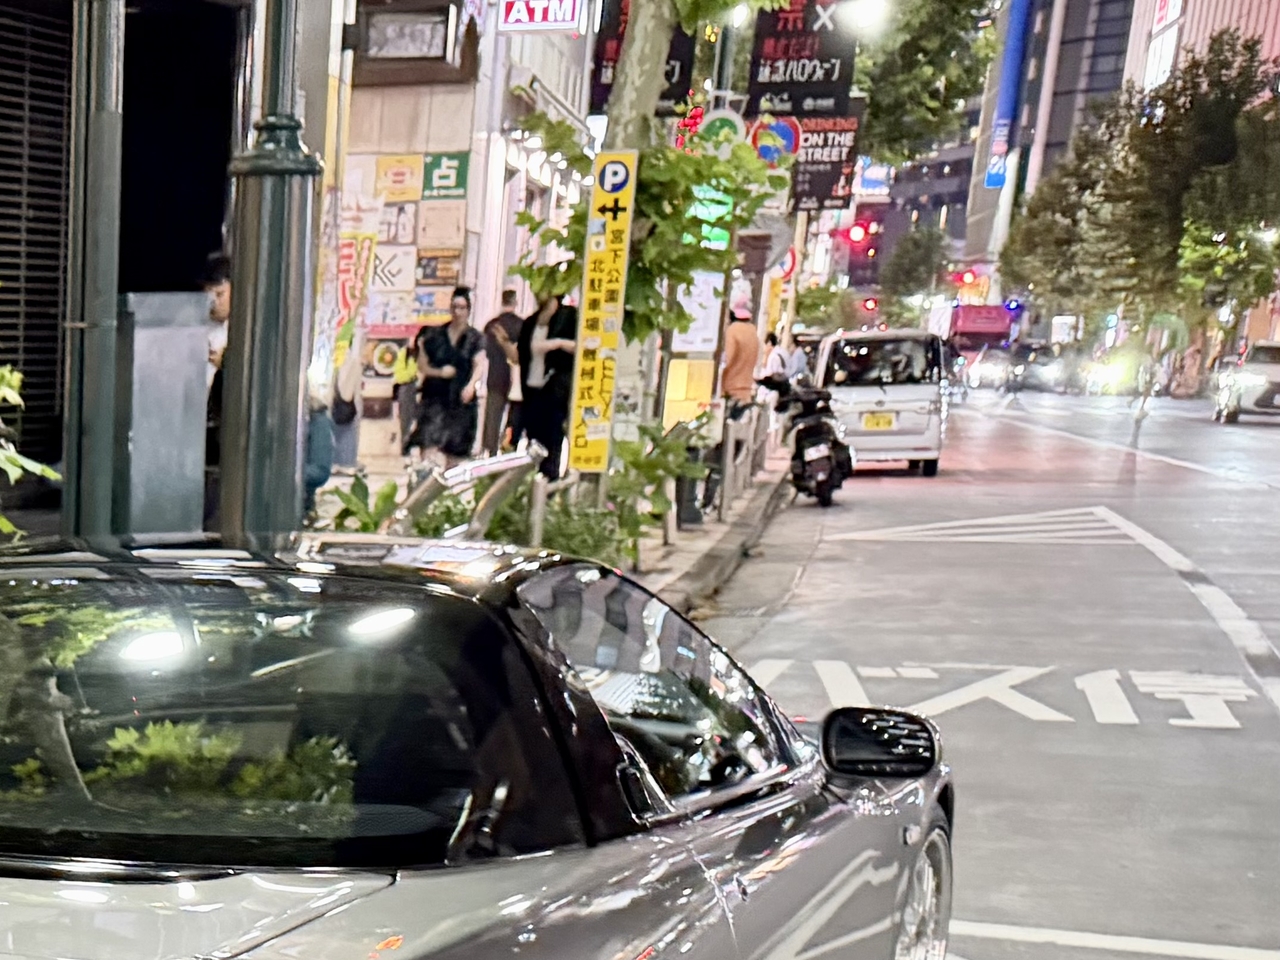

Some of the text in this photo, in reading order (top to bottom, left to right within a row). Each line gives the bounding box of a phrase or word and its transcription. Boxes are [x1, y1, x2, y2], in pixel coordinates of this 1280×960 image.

[507, 0, 572, 24] ATM
[800, 130, 855, 147] ON THE
[797, 146, 850, 162] STREET
[432, 156, 459, 187] 占
[603, 163, 627, 192] P
